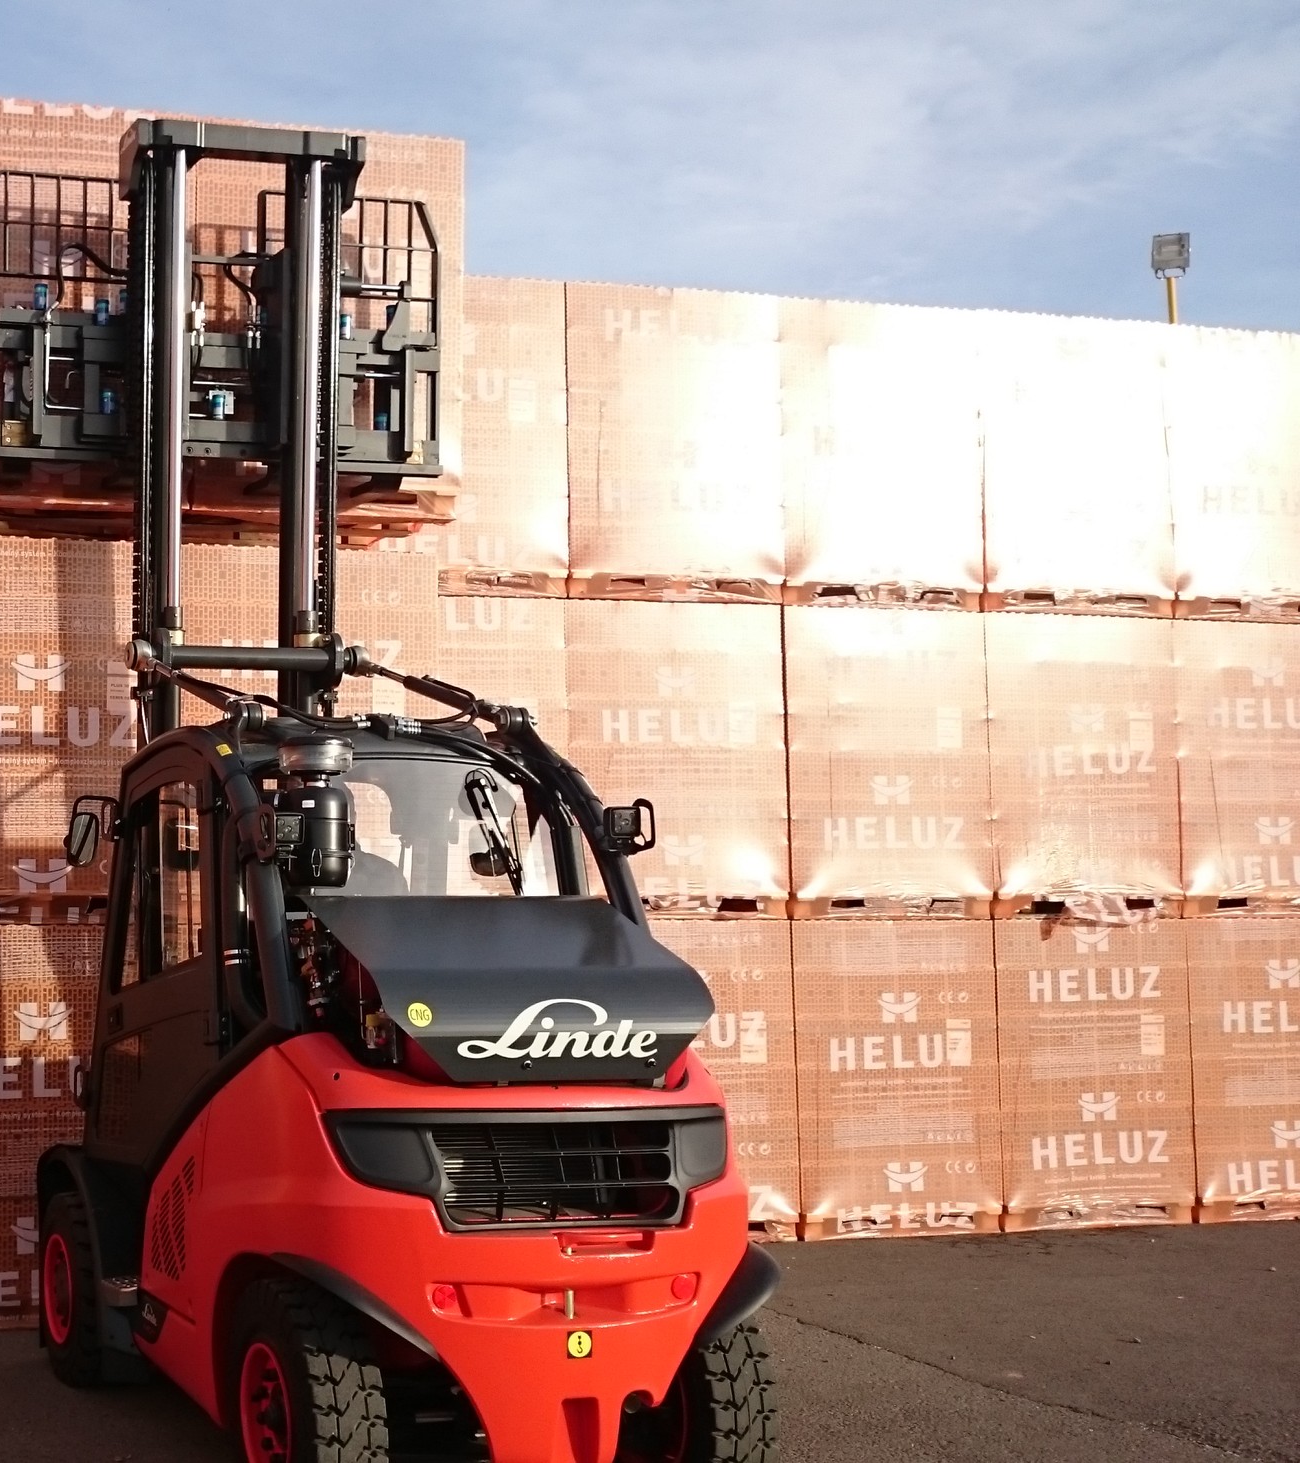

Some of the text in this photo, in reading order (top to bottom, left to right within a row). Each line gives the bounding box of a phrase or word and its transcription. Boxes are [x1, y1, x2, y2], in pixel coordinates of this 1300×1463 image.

[824, 816, 965, 850] HELUZ
[1028, 966, 1161, 1002] HELUZ
[409, 1008, 430, 1021] CNG
[457, 998, 658, 1059] Linde
[1031, 1130, 1169, 1170] HELUZ
[837, 1201, 977, 1233] HELUZ
